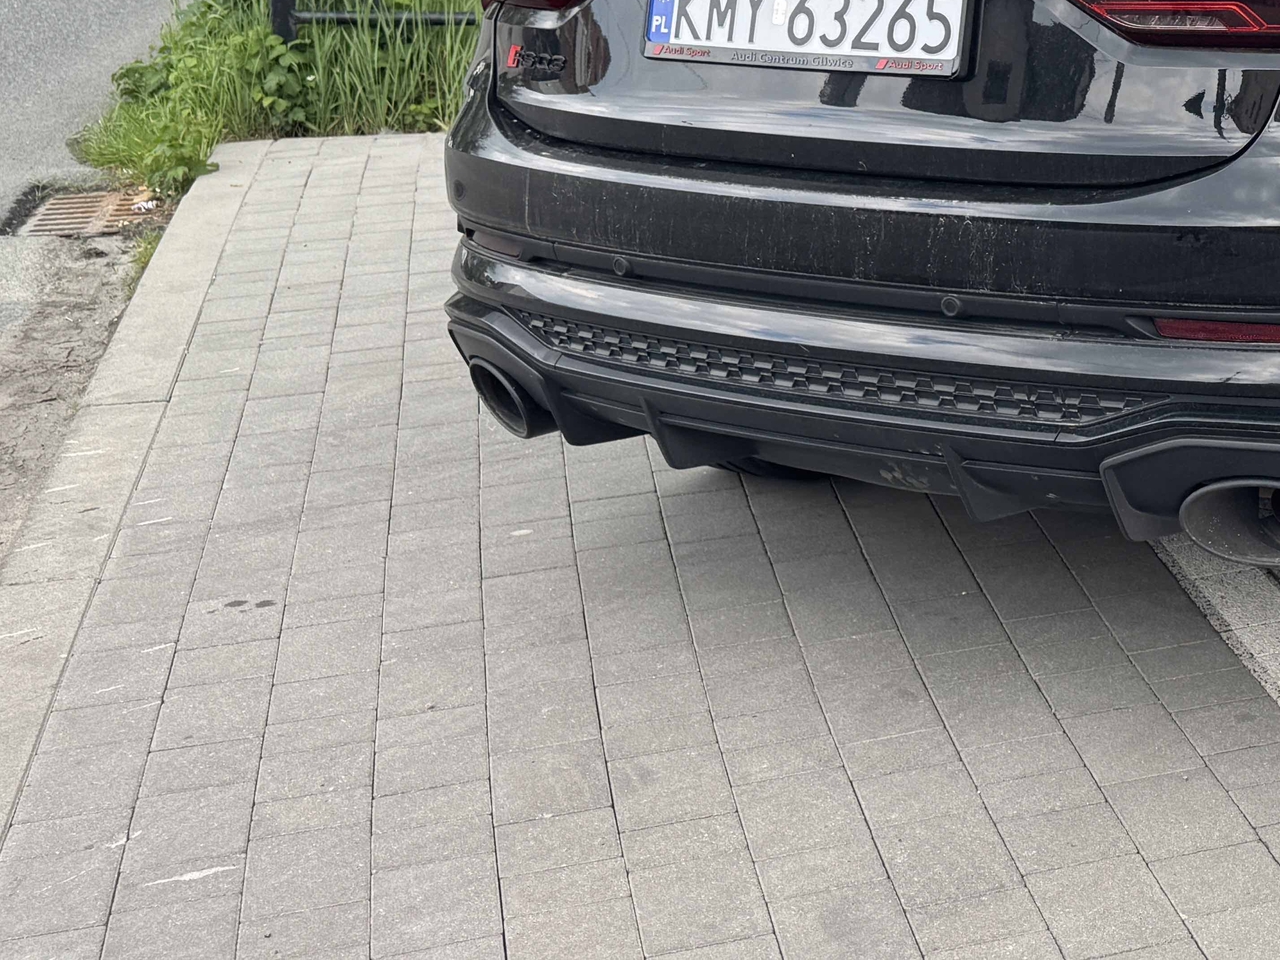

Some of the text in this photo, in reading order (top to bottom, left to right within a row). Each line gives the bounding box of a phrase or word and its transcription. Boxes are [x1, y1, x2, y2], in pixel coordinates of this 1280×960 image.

[651, 15, 668, 33] PL
[663, 45, 711, 58] Audi Sport
[731, 51, 853, 69] Audi Centrum Gliwice
[887, 59, 943, 71] Audi Sport
